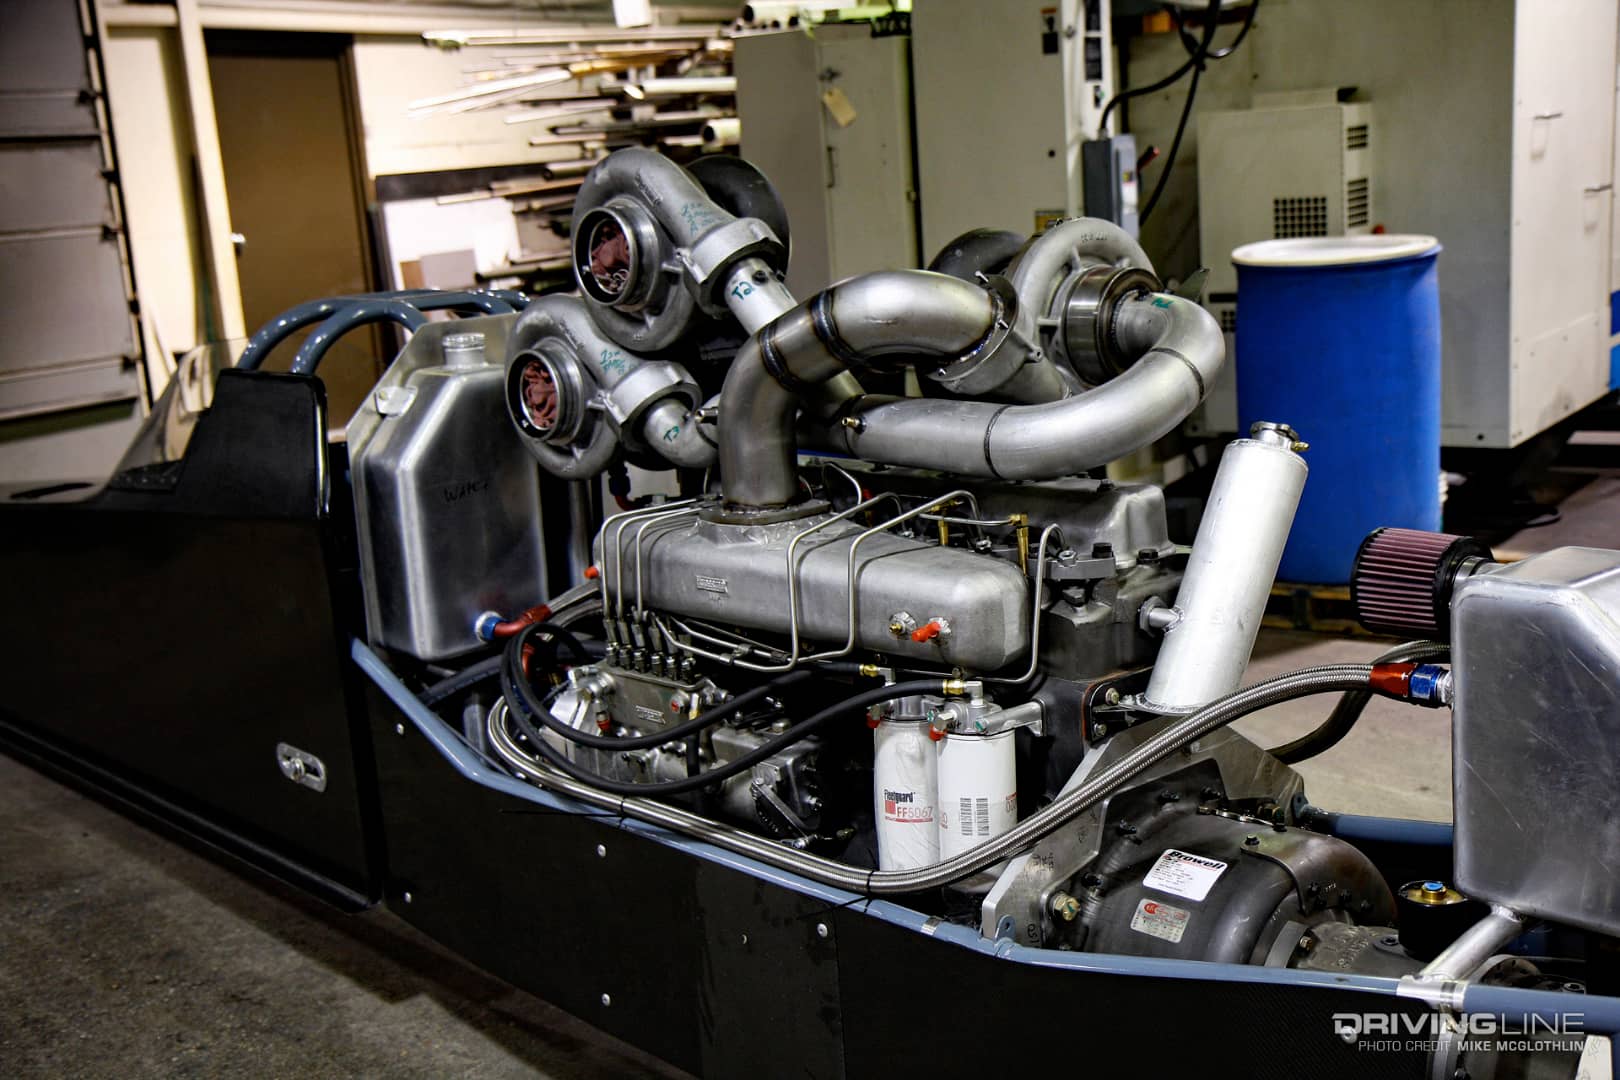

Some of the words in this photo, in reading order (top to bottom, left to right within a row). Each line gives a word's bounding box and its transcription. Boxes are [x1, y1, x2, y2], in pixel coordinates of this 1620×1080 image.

[731, 280, 754, 300] T2
[884, 789, 914, 804] Fleetguard
[897, 806, 934, 818] FF5067
[1168, 851, 1225, 869] Browell
